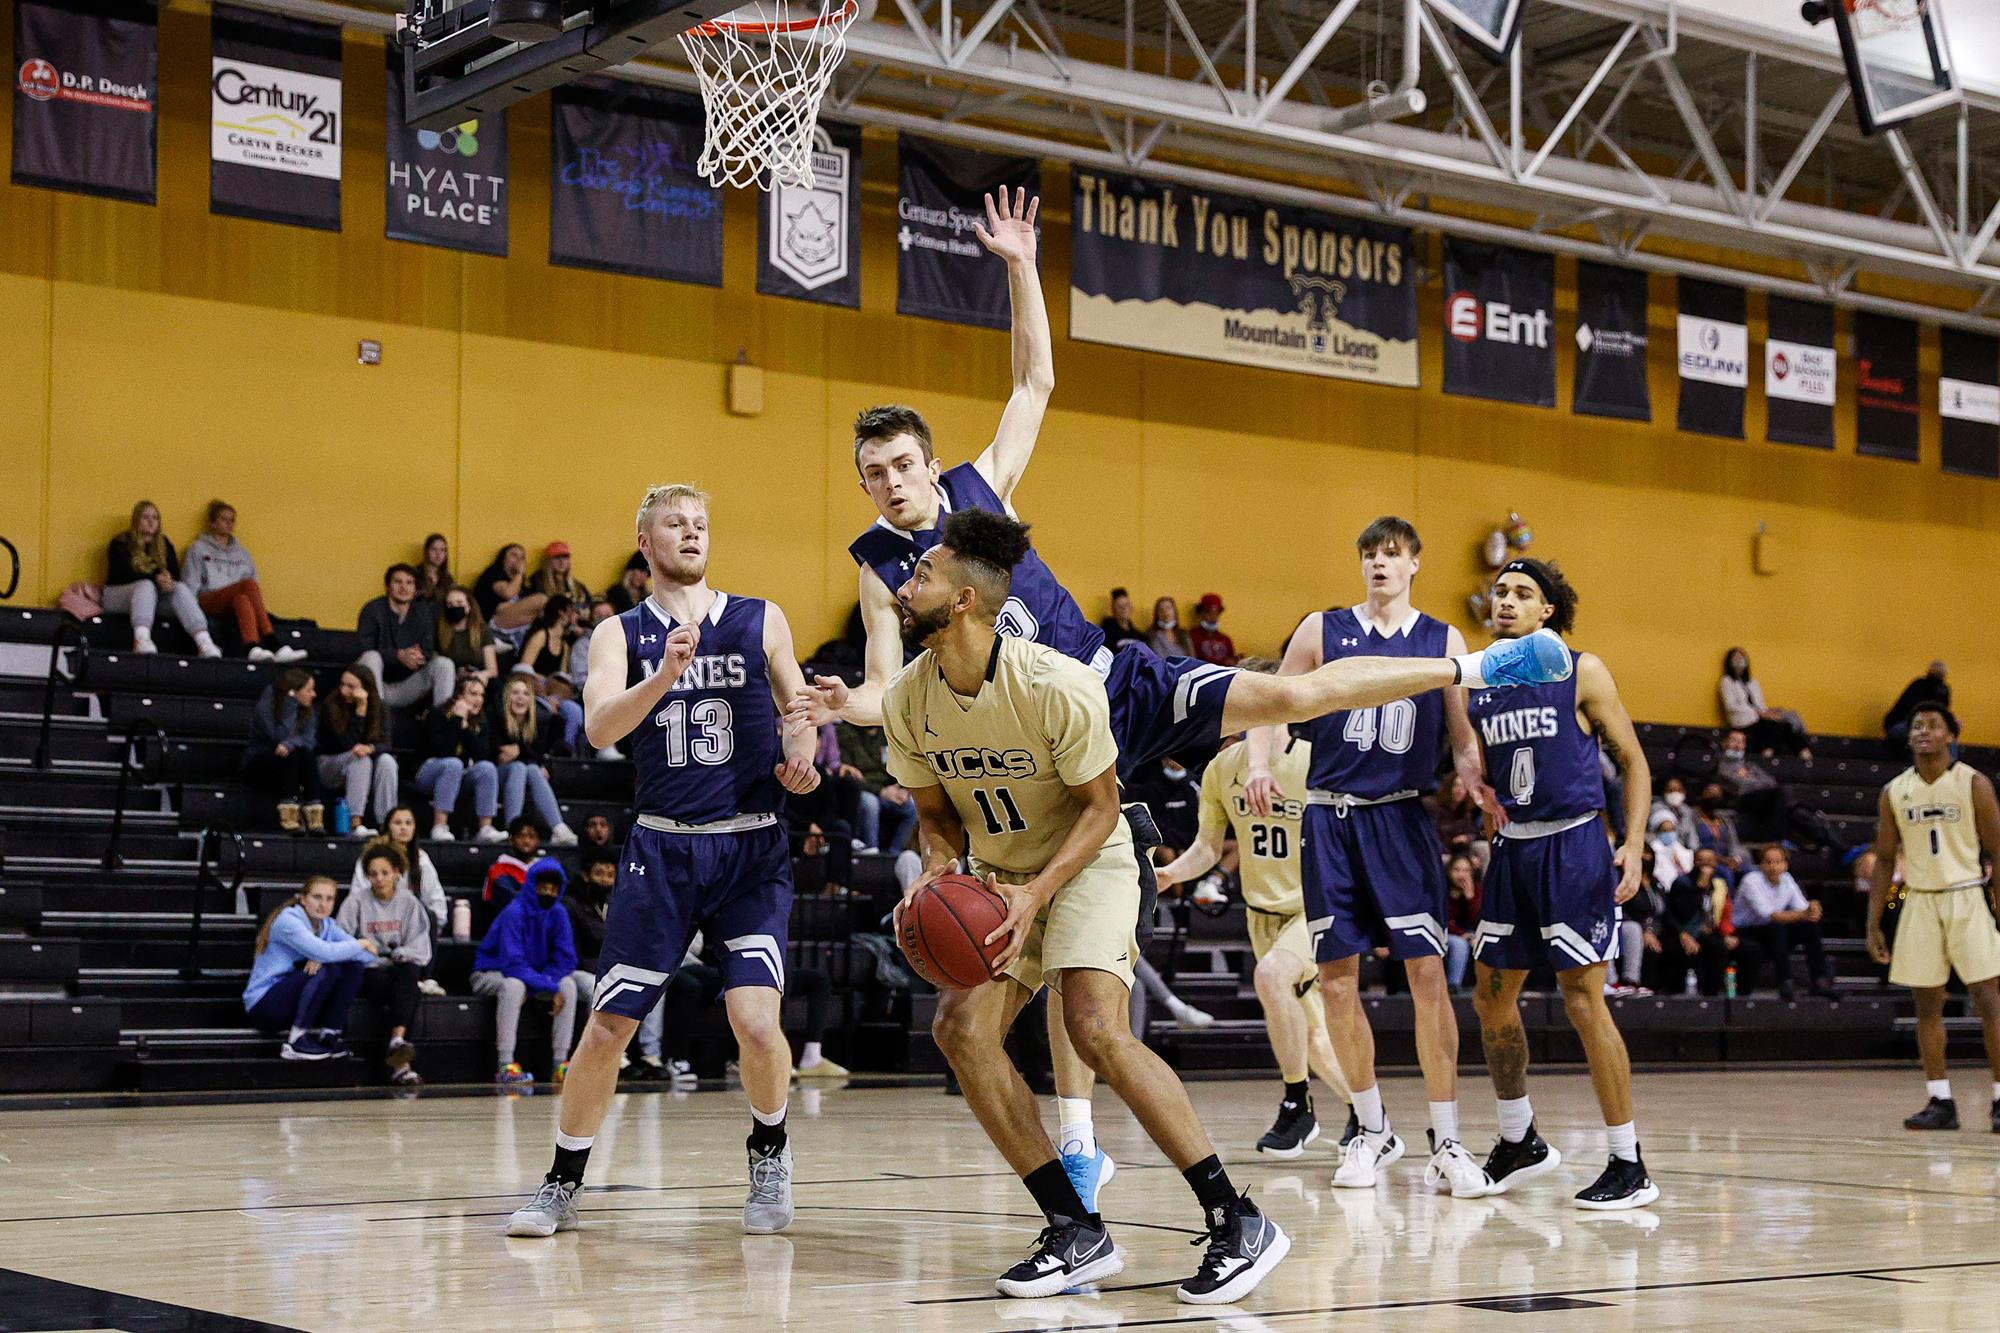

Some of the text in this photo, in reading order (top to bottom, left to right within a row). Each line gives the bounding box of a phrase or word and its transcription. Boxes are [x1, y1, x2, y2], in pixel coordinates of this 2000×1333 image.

[99, 78, 147, 101] Dough
[213, 69, 319, 118] Century
[309, 110, 336, 145] 21
[390, 161, 504, 202] HYATT
[407, 194, 491, 226] PLACE
[1079, 175, 1403, 287] Thank You Sponsors
[1224, 317, 1307, 350] Mountain
[1333, 332, 1379, 361] Lions
[1485, 301, 1550, 349] Ent
[655, 698, 734, 768] 13
[1343, 697, 1417, 755] 40
[1481, 706, 1560, 747] MINES
[926, 747, 1037, 780] UCCS
[1510, 746, 1536, 806] 4
[972, 787, 1029, 836] 11
[1232, 795, 1304, 822] UCS
[1250, 822, 1290, 861] 20
[1929, 827, 1940, 856] 1
